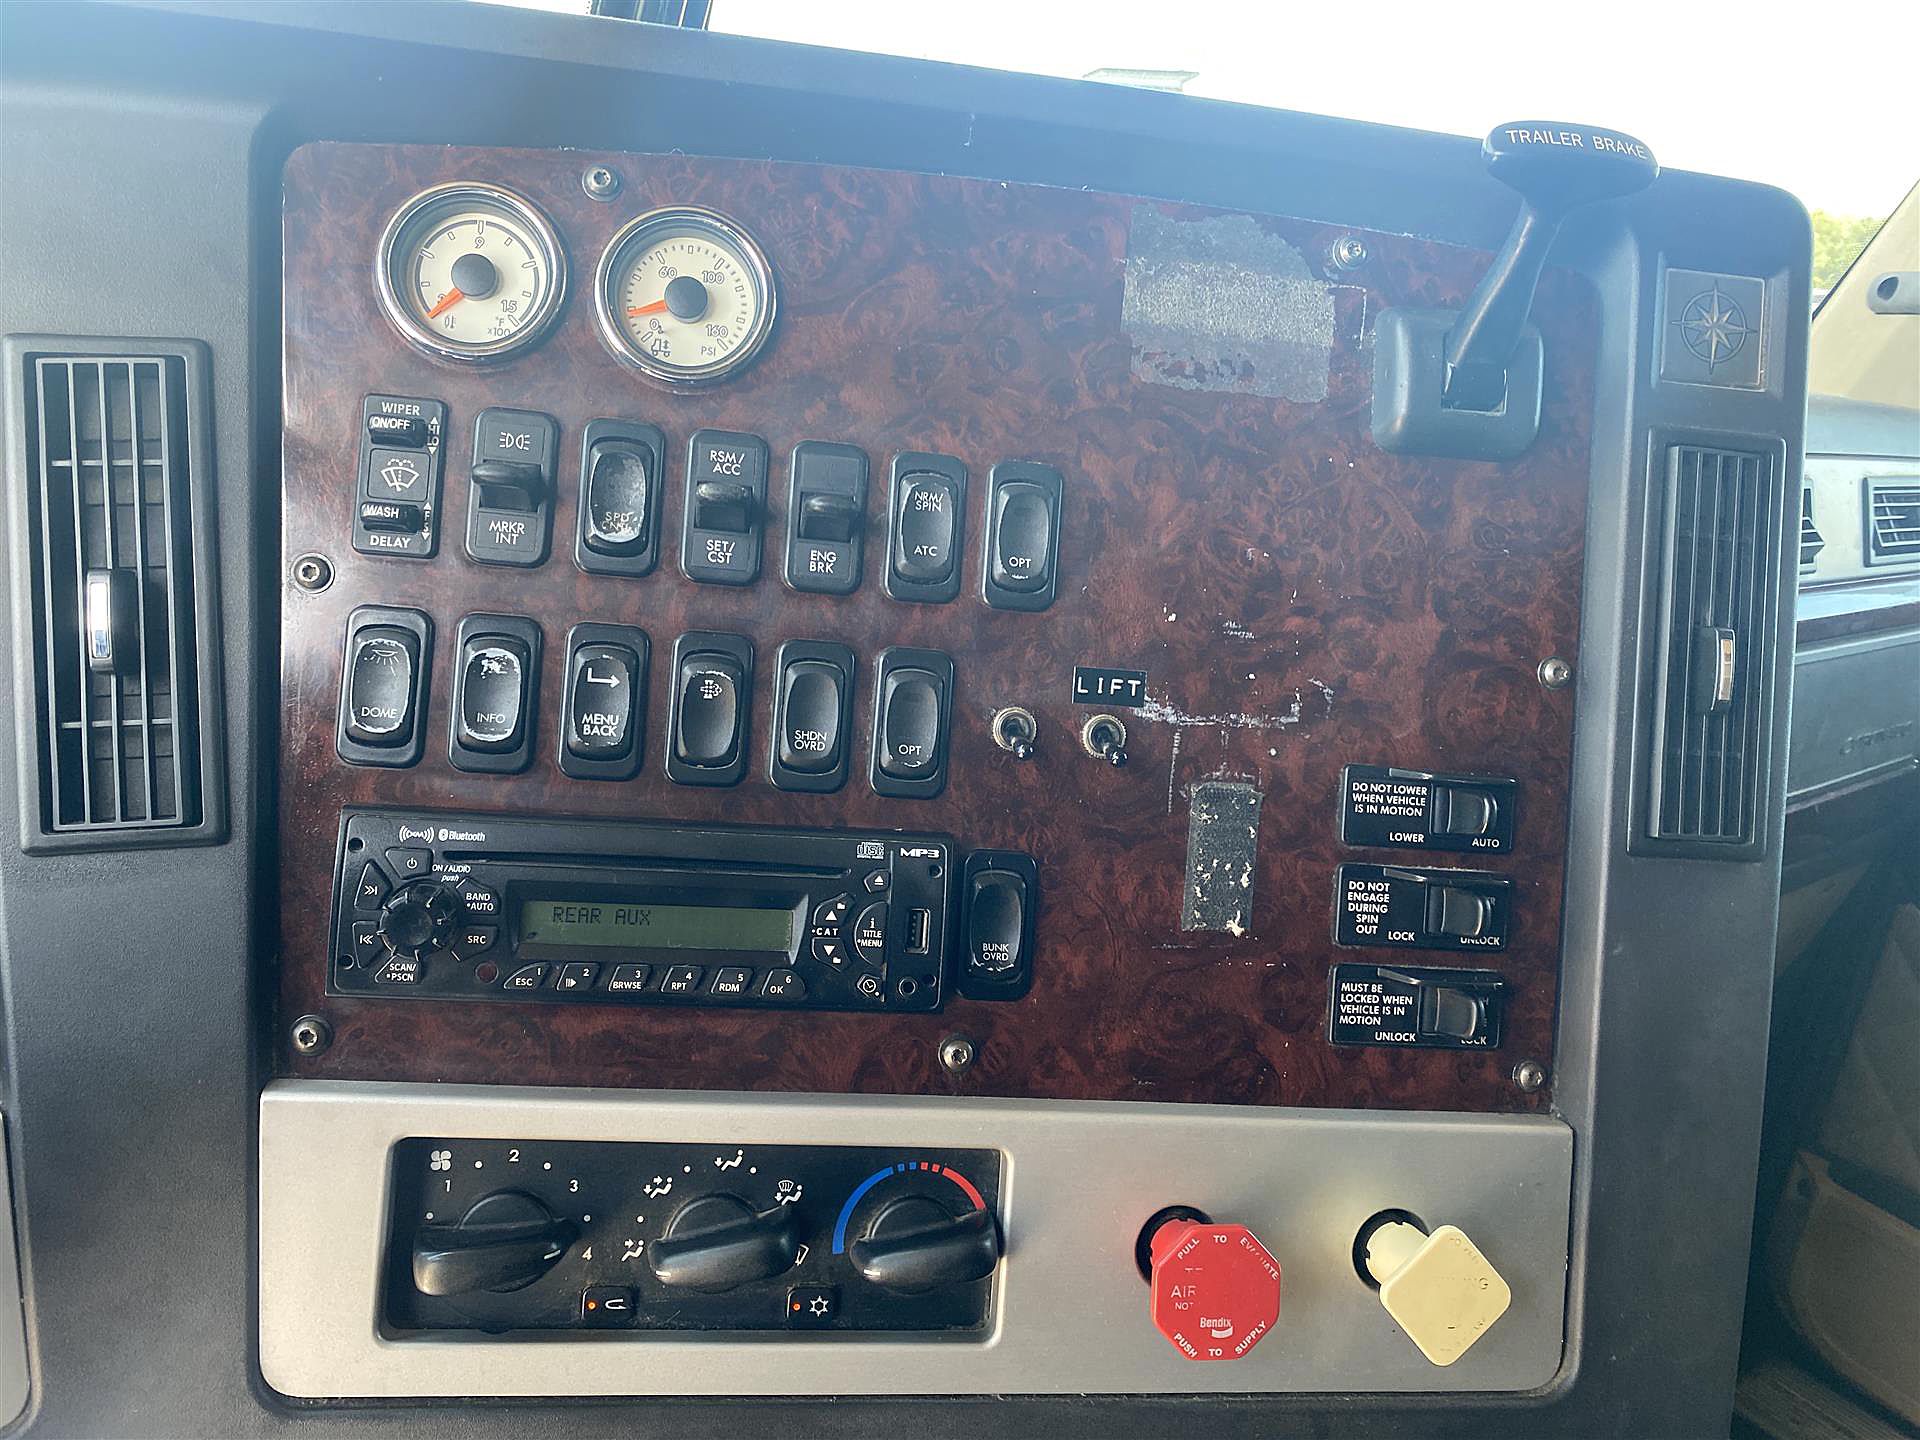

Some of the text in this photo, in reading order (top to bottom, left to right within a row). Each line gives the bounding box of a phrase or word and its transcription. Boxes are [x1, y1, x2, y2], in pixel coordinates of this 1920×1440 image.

[1506, 129, 1648, 160] TRAILER BRAKE
[474, 236, 485, 249] 9
[658, 266, 678, 279] 60
[701, 271, 725, 284] 100
[500, 298, 517, 313] 15
[649, 318, 660, 331] 0
[705, 323, 729, 338] 160
[701, 345, 717, 357] PSI
[381, 401, 421, 416] WIPER
[371, 416, 411, 430] ON/OFF
[428, 425, 441, 436] HI
[427, 436, 440, 447] LO
[709, 450, 745, 464] RSM/
[712, 462, 742, 476] ACC
[914, 491, 944, 504] NRM/
[364, 504, 400, 519] WASH
[915, 500, 942, 513] SPIN
[605, 511, 630, 523] SPD
[489, 520, 525, 535] MRKR
[369, 535, 411, 549] DELAY
[495, 533, 519, 546] INT
[706, 539, 736, 553] SET/
[913, 545, 938, 557] ATC
[707, 551, 733, 565] CST
[810, 550, 837, 563] ENG
[809, 561, 835, 574] BRK
[1009, 557, 1032, 569] OPT
[1077, 676, 1142, 697] LIFT
[361, 706, 397, 719] DOME
[476, 711, 505, 724] INFO
[581, 713, 619, 727] MENU
[583, 724, 618, 738] BACK
[794, 730, 828, 742] SHDN
[794, 739, 826, 751] OVRD
[898, 744, 922, 756] OPT
[1352, 782, 1428, 796] DO NOT LOWER
[1352, 793, 1426, 807] WHEN VEHICLE
[1354, 804, 1423, 817] IS IN MOTION
[448, 830, 486, 842] Bluetooth
[1389, 832, 1425, 843] LOWER
[1472, 838, 1500, 848] AUTO
[900, 847, 940, 858] MP3
[440, 874, 460, 882] push
[1348, 881, 1390, 892] DO NOT
[466, 891, 491, 902] BAND
[1347, 892, 1390, 903] ENGAGE
[1348, 902, 1388, 913] DURING
[553, 906, 651, 926] REAR AUX
[1356, 914, 1379, 924] SPIN
[862, 929, 882, 938] TITLE
[1355, 925, 1378, 935] OUT
[467, 935, 486, 944] SRC
[1388, 931, 1415, 942] LOCK
[982, 942, 1009, 953] BUNK
[982, 951, 1009, 962] OVRD
[389, 963, 417, 972] SCAN/
[583, 968, 590, 977] 2
[635, 970, 641, 978] 3
[685, 972, 693, 980] 4
[738, 973, 744, 982] 5
[785, 975, 792, 984] 6
[515, 977, 533, 986] ESC
[612, 981, 642, 990] BRWSE
[671, 982, 687, 991] RPT
[719, 983, 740, 992] RDM
[1341, 982, 1383, 993] MUST BE
[769, 985, 784, 994] OK
[1340, 993, 1413, 1005] LOCKED WHEN
[1340, 1004, 1405, 1016] VEHICLE IS IN
[1339, 1015, 1381, 1026] MOTION
[1375, 1031, 1416, 1042] UNLOCK
[508, 1150, 520, 1163] 2
[444, 1180, 451, 1193] 1
[569, 1180, 579, 1193] 3
[582, 1246, 593, 1261] 4
[1177, 1235, 1280, 1280] PULL TO EVATE
[1199, 1317, 1232, 1329] Bendix
[1173, 1320, 1267, 1358] PUSH TO SUPPLY
